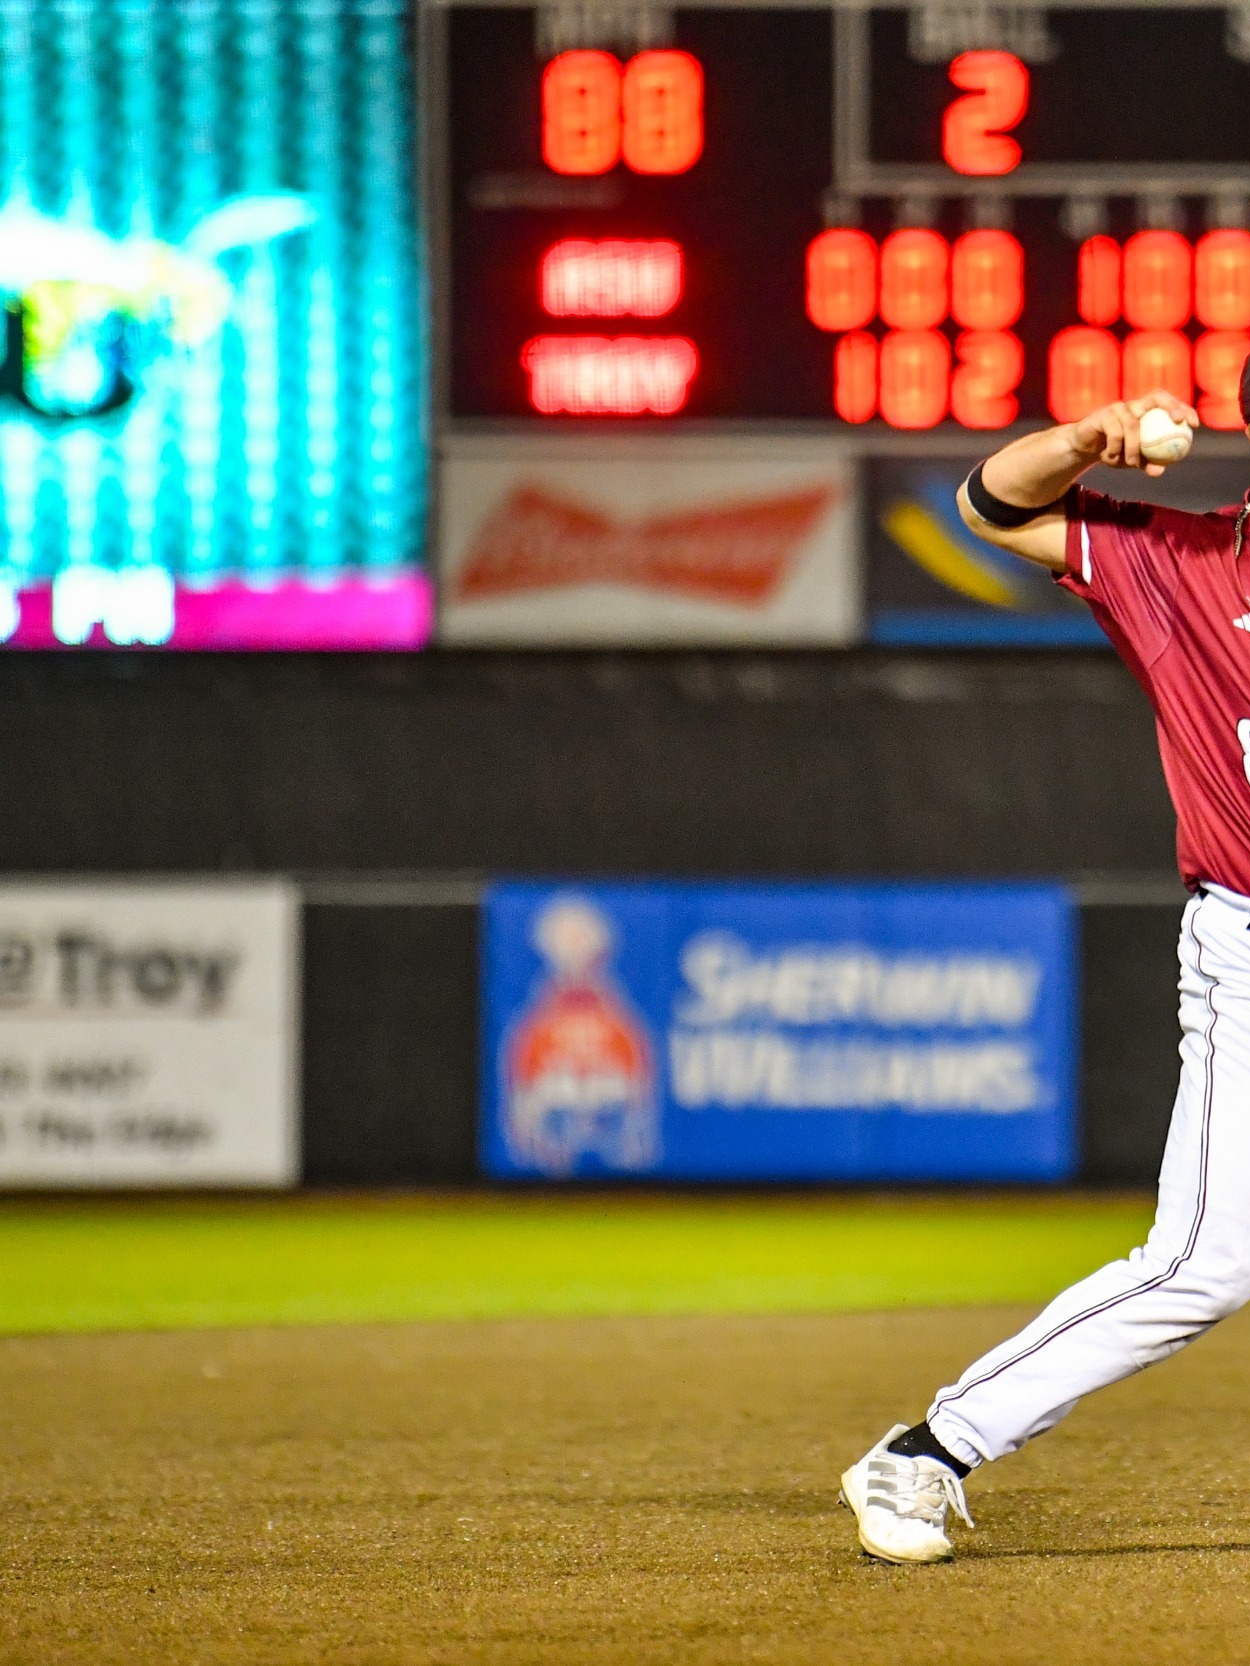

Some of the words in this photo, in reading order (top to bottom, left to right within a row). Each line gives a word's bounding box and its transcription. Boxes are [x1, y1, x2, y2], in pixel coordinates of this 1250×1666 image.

[942, 50, 1028, 176] 2
[1078, 235, 1122, 326] 1
[833, 331, 877, 424] 1
[951, 331, 1024, 430] 2
[54, 930, 243, 1020] Troy
